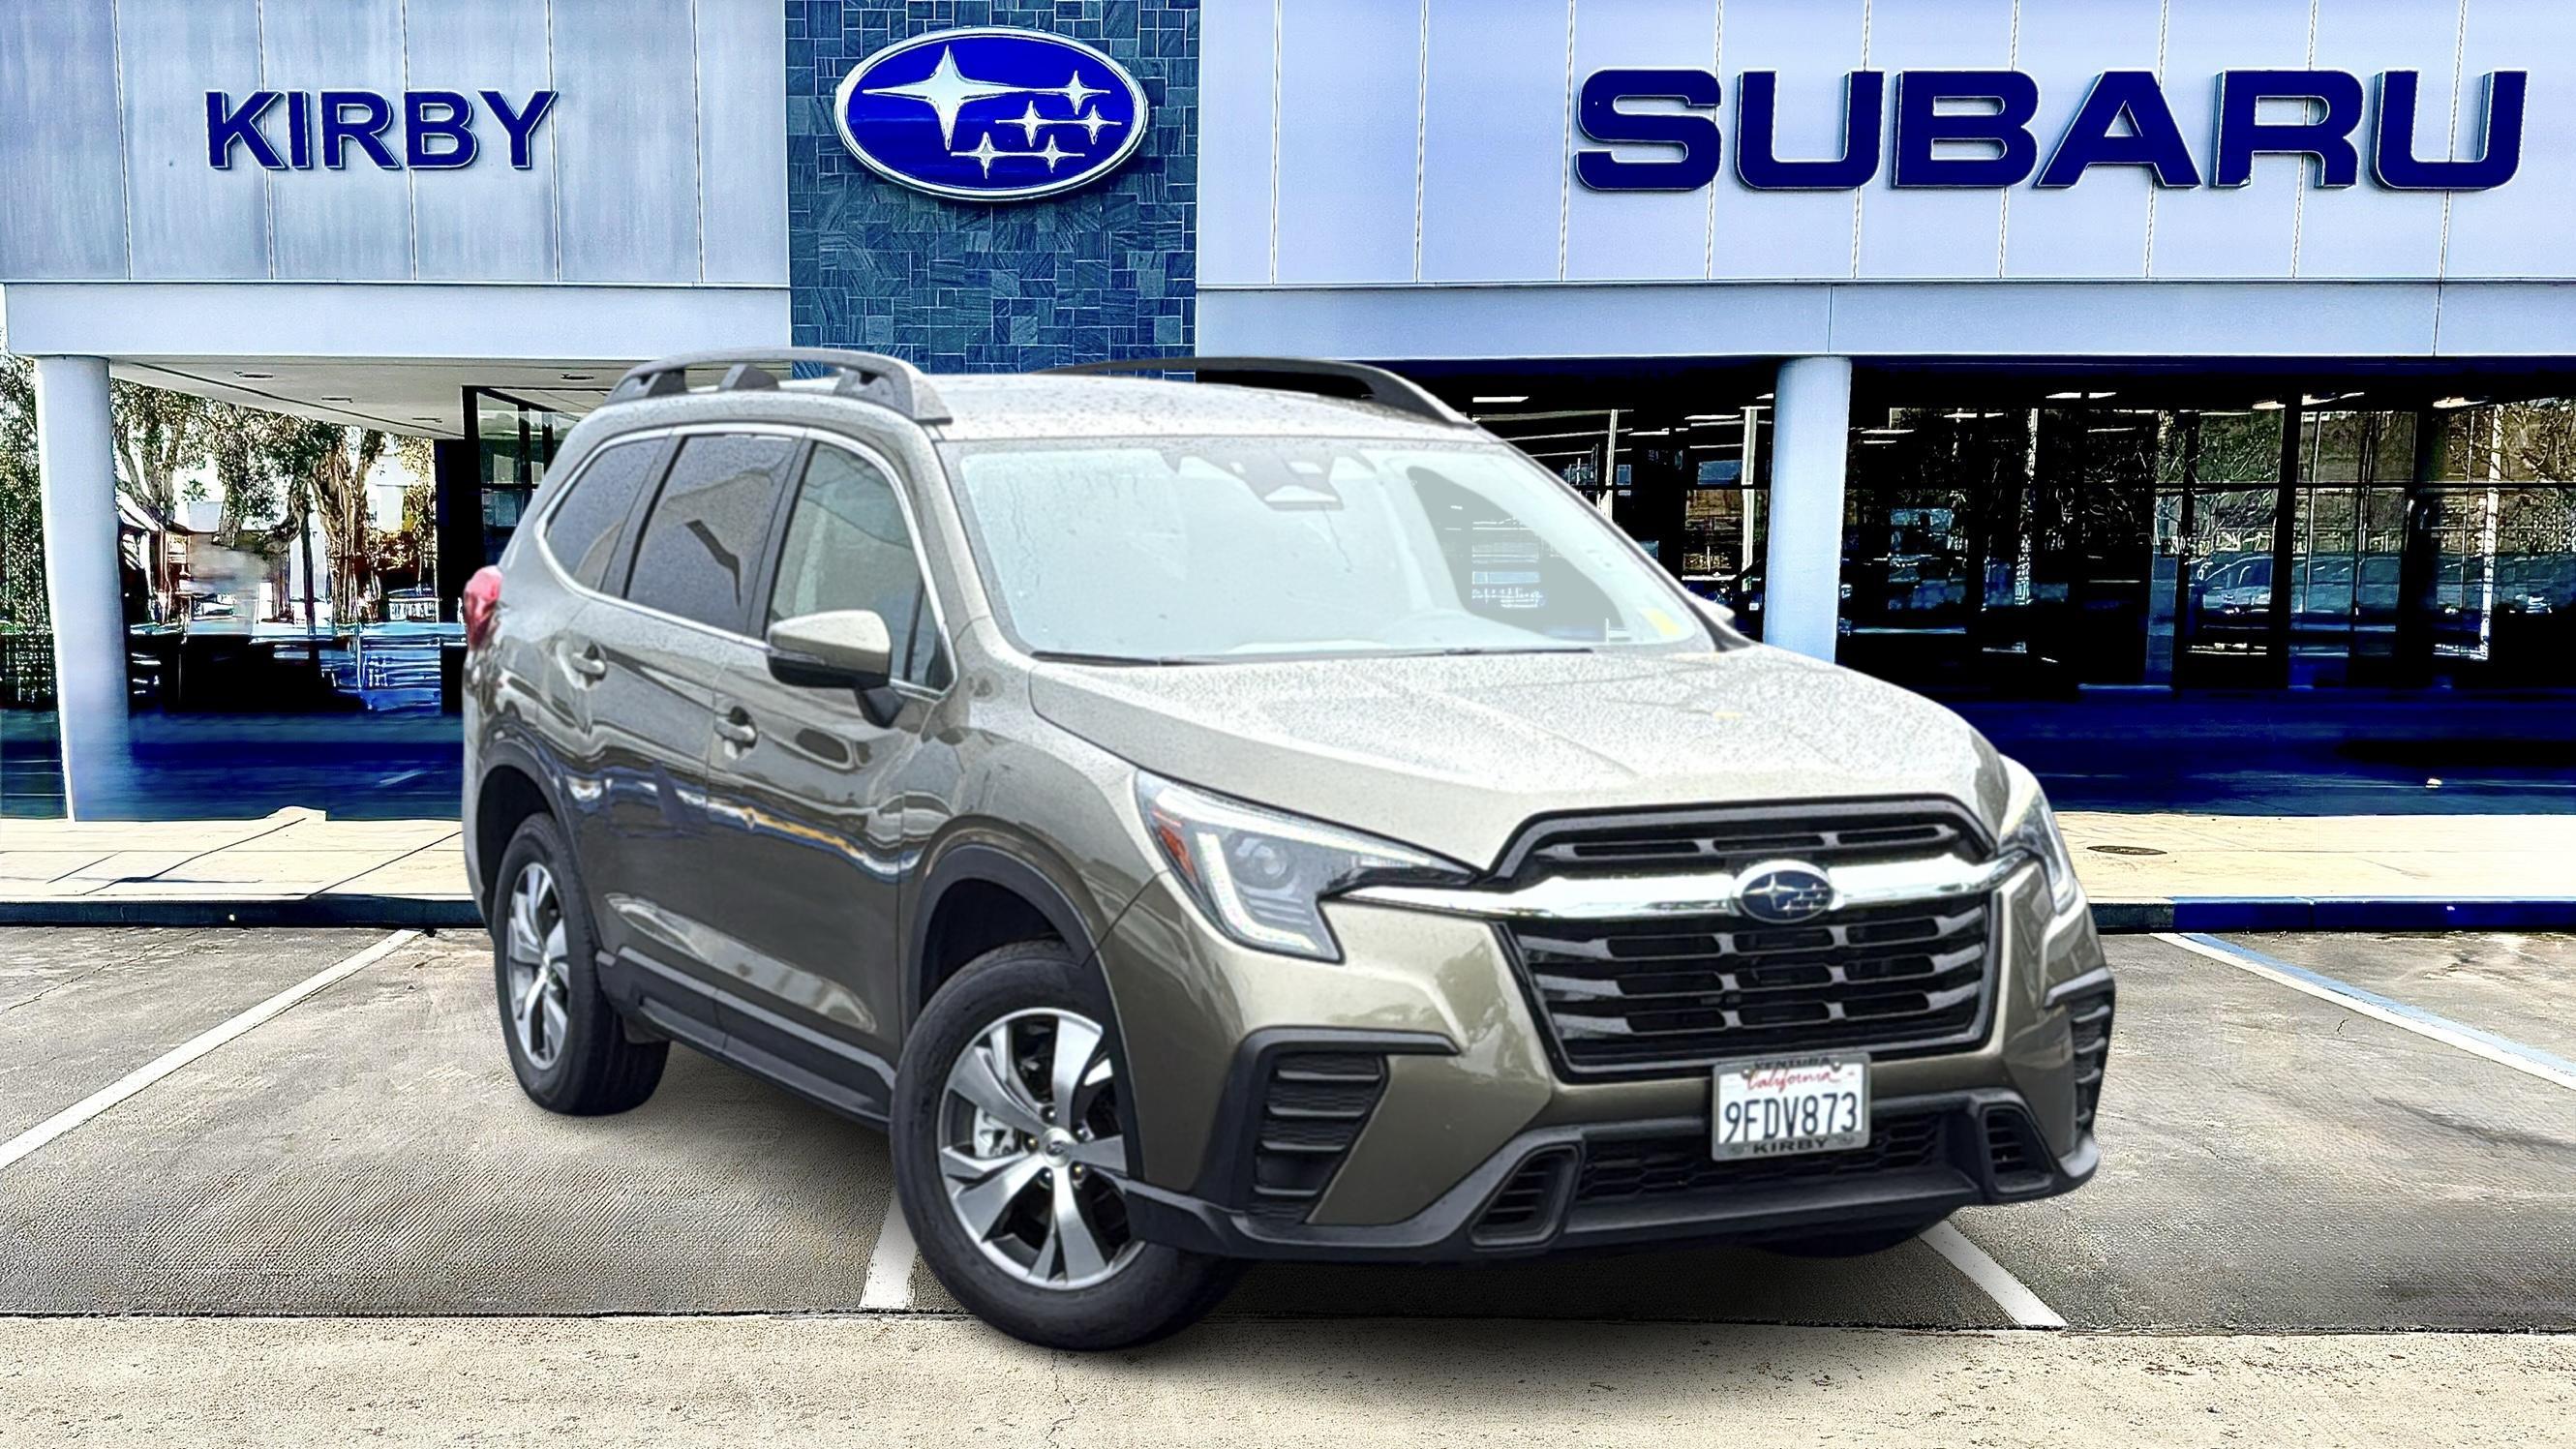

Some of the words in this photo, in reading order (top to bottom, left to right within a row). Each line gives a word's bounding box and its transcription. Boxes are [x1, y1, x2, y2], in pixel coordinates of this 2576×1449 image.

[204, 89, 559, 170] KIRBY
[1575, 68, 2528, 191] SUBARU
[1746, 1069, 1839, 1093] California
[1724, 1092, 1857, 1143] 9FDV873
[1753, 1137, 1829, 1154] KIRBY
